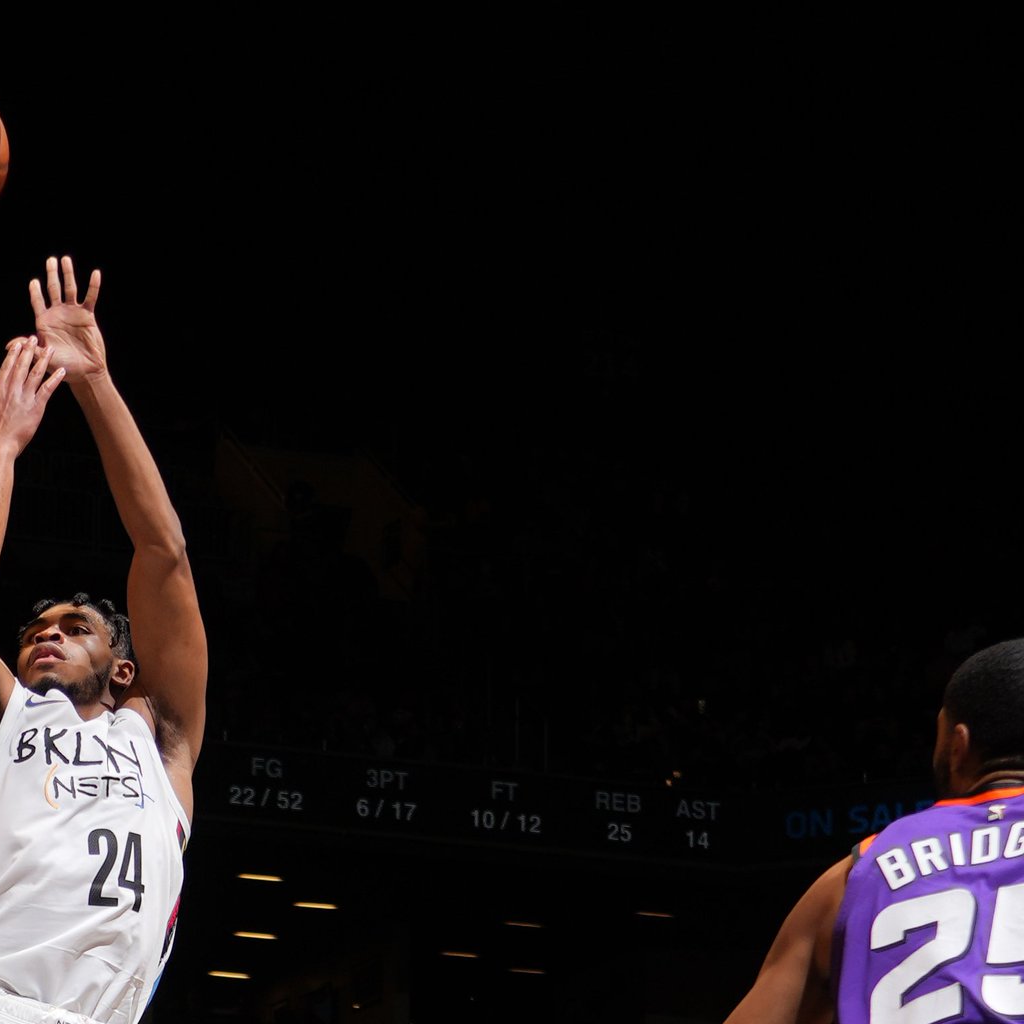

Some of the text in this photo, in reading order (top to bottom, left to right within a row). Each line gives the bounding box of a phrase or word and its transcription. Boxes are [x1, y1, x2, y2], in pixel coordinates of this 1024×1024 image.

[251, 757, 284, 779] FG
[365, 767, 409, 791] 3PT
[491, 780, 519, 801] FT
[594, 790, 643, 814] REB
[676, 799, 721, 822] AST
[607, 822, 633, 843] 25
[784, 808, 834, 840] ON
[686, 829, 710, 849] 14
[87, 827, 146, 913] 24
